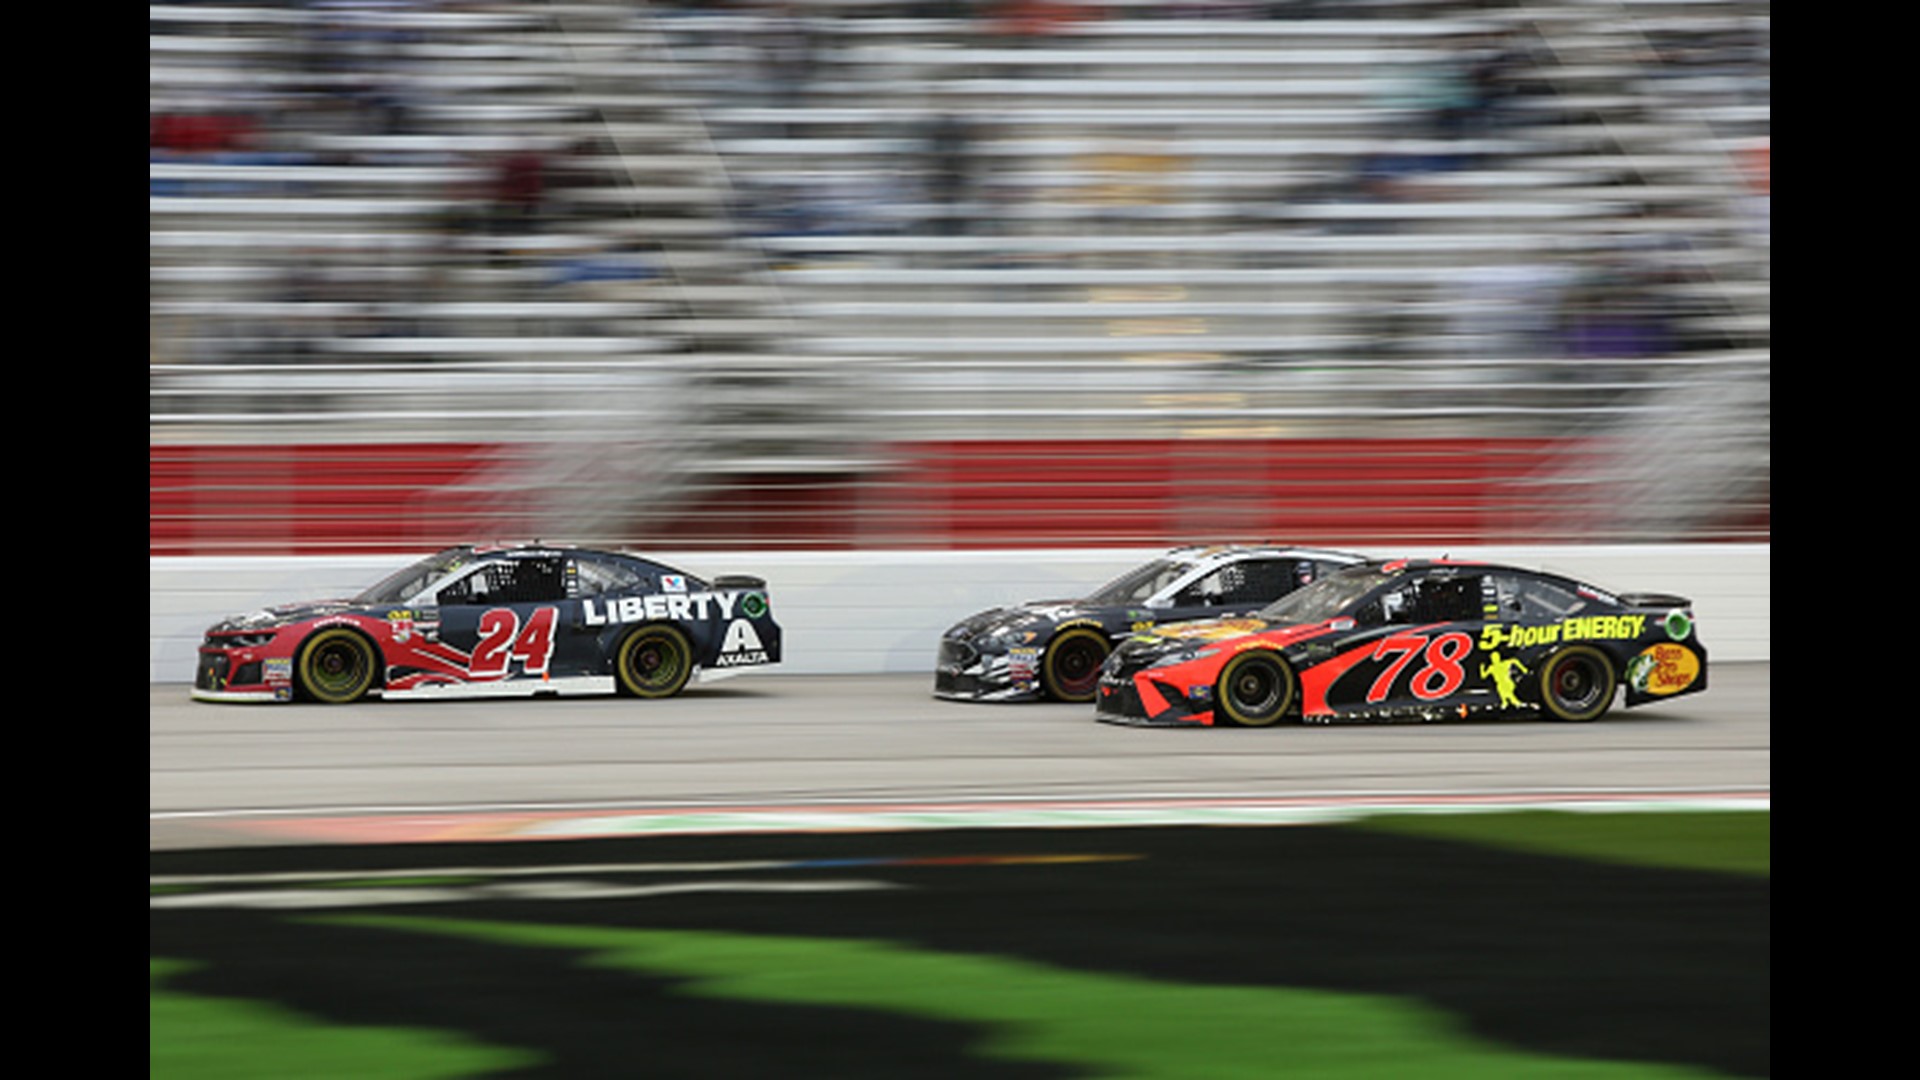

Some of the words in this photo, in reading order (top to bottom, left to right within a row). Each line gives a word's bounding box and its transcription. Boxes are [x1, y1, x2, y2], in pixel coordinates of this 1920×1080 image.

[583, 591, 738, 626] LIBERTY
[469, 605, 559, 674] 24
[1478, 624, 1561, 650] 5-hour
[1562, 615, 1646, 641] ENERGY
[715, 651, 769, 666] AXALTA
[1366, 632, 1473, 703] 78
[1654, 673, 1691, 689] Shops
